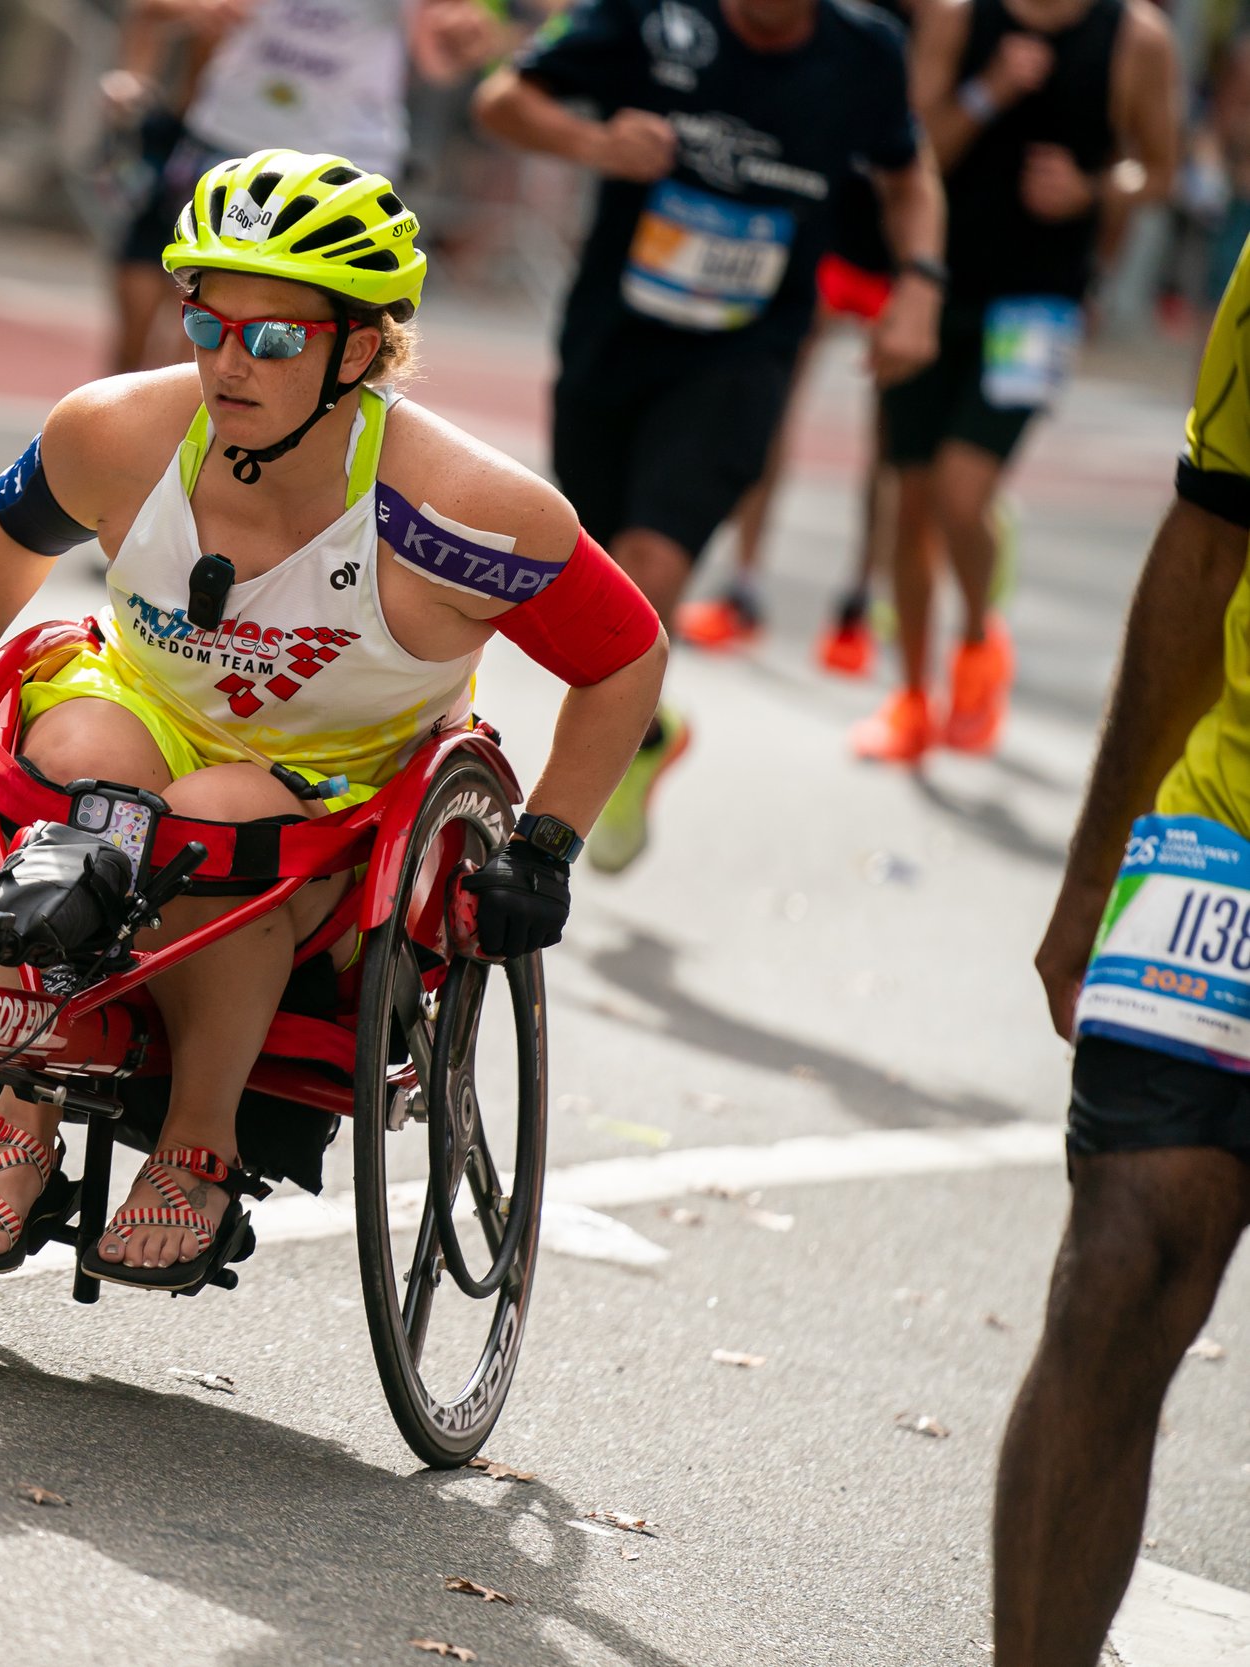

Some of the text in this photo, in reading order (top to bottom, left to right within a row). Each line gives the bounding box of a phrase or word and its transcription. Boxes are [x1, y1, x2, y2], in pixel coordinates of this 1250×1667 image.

[377, 500, 391, 524] KT
[403, 520, 461, 567] KT
[132, 617, 274, 676] FREEDOM TEAM
[1141, 964, 1209, 1001] 2022
[16, 1000, 60, 1046] END
